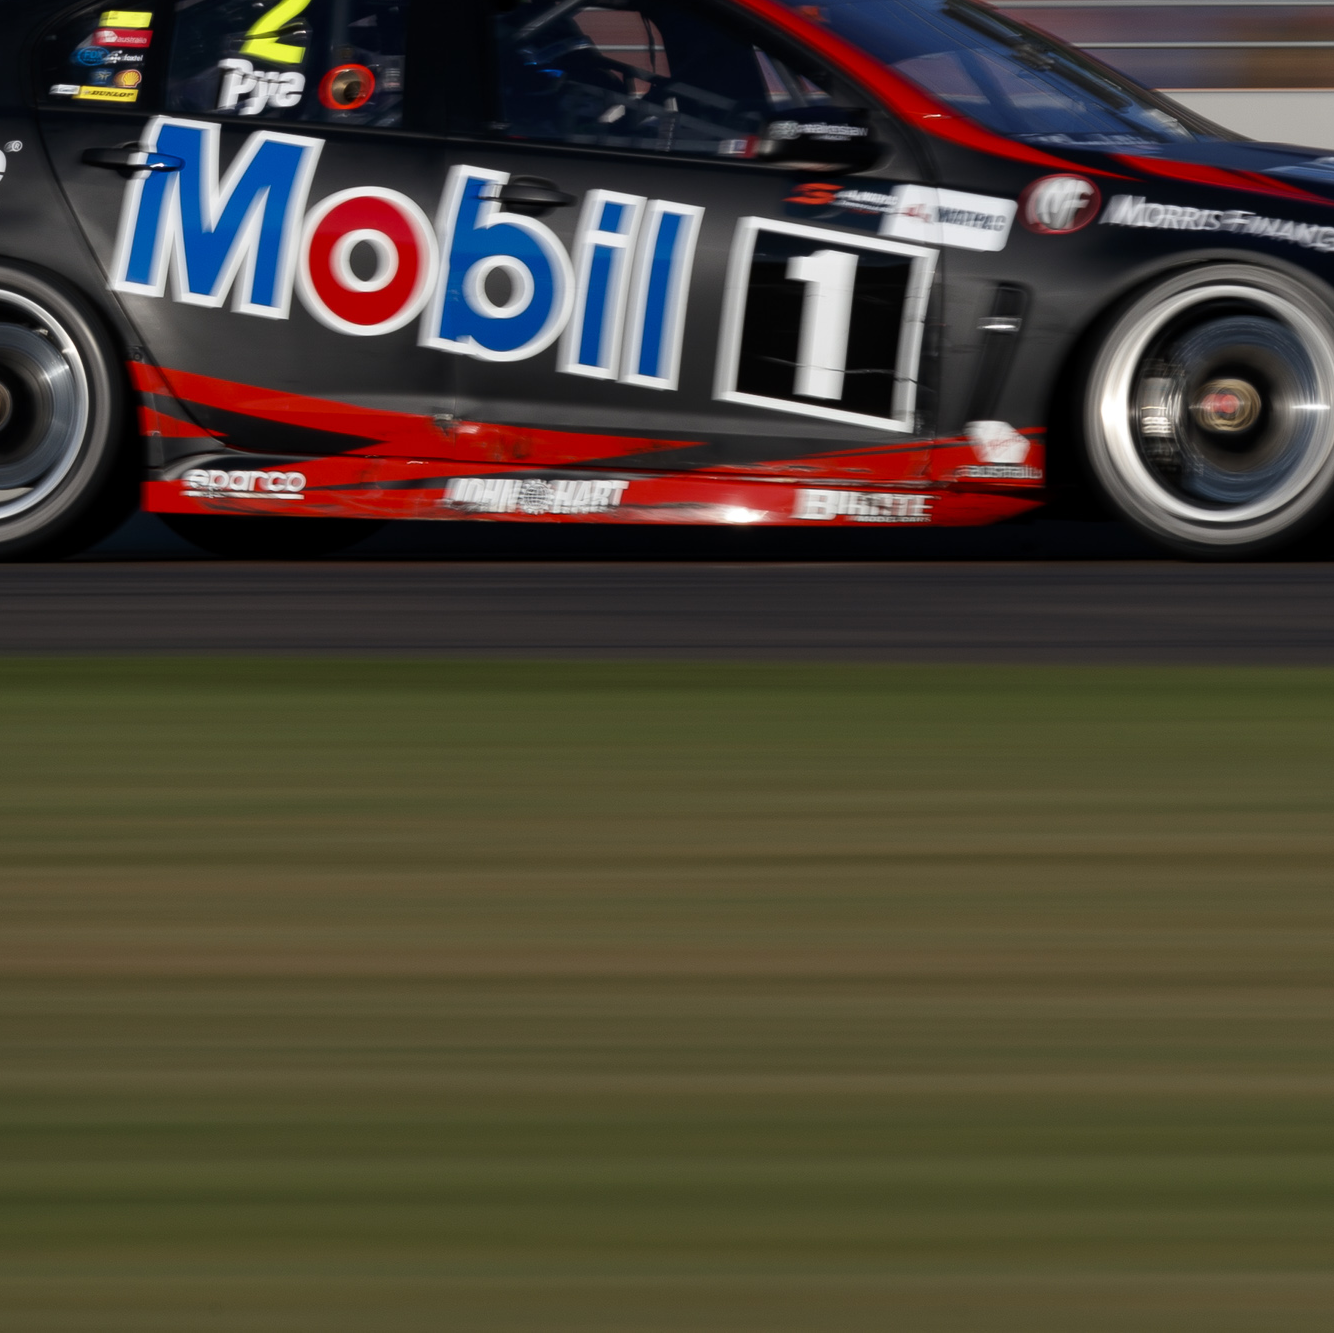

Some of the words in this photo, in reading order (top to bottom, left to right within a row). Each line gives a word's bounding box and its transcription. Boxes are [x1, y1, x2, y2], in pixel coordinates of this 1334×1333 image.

[90, 90, 135, 99] DUNLOP
[217, 58, 307, 116] Pye
[937, 206, 1007, 232] WATPAC
[1099, 194, 1224, 231] MORRIS
[108, 114, 705, 392] Mobil
[784, 248, 859, 401] 1
[181, 469, 307, 492] sparco
[443, 478, 522, 513] JOHN
[548, 479, 630, 514] HART
